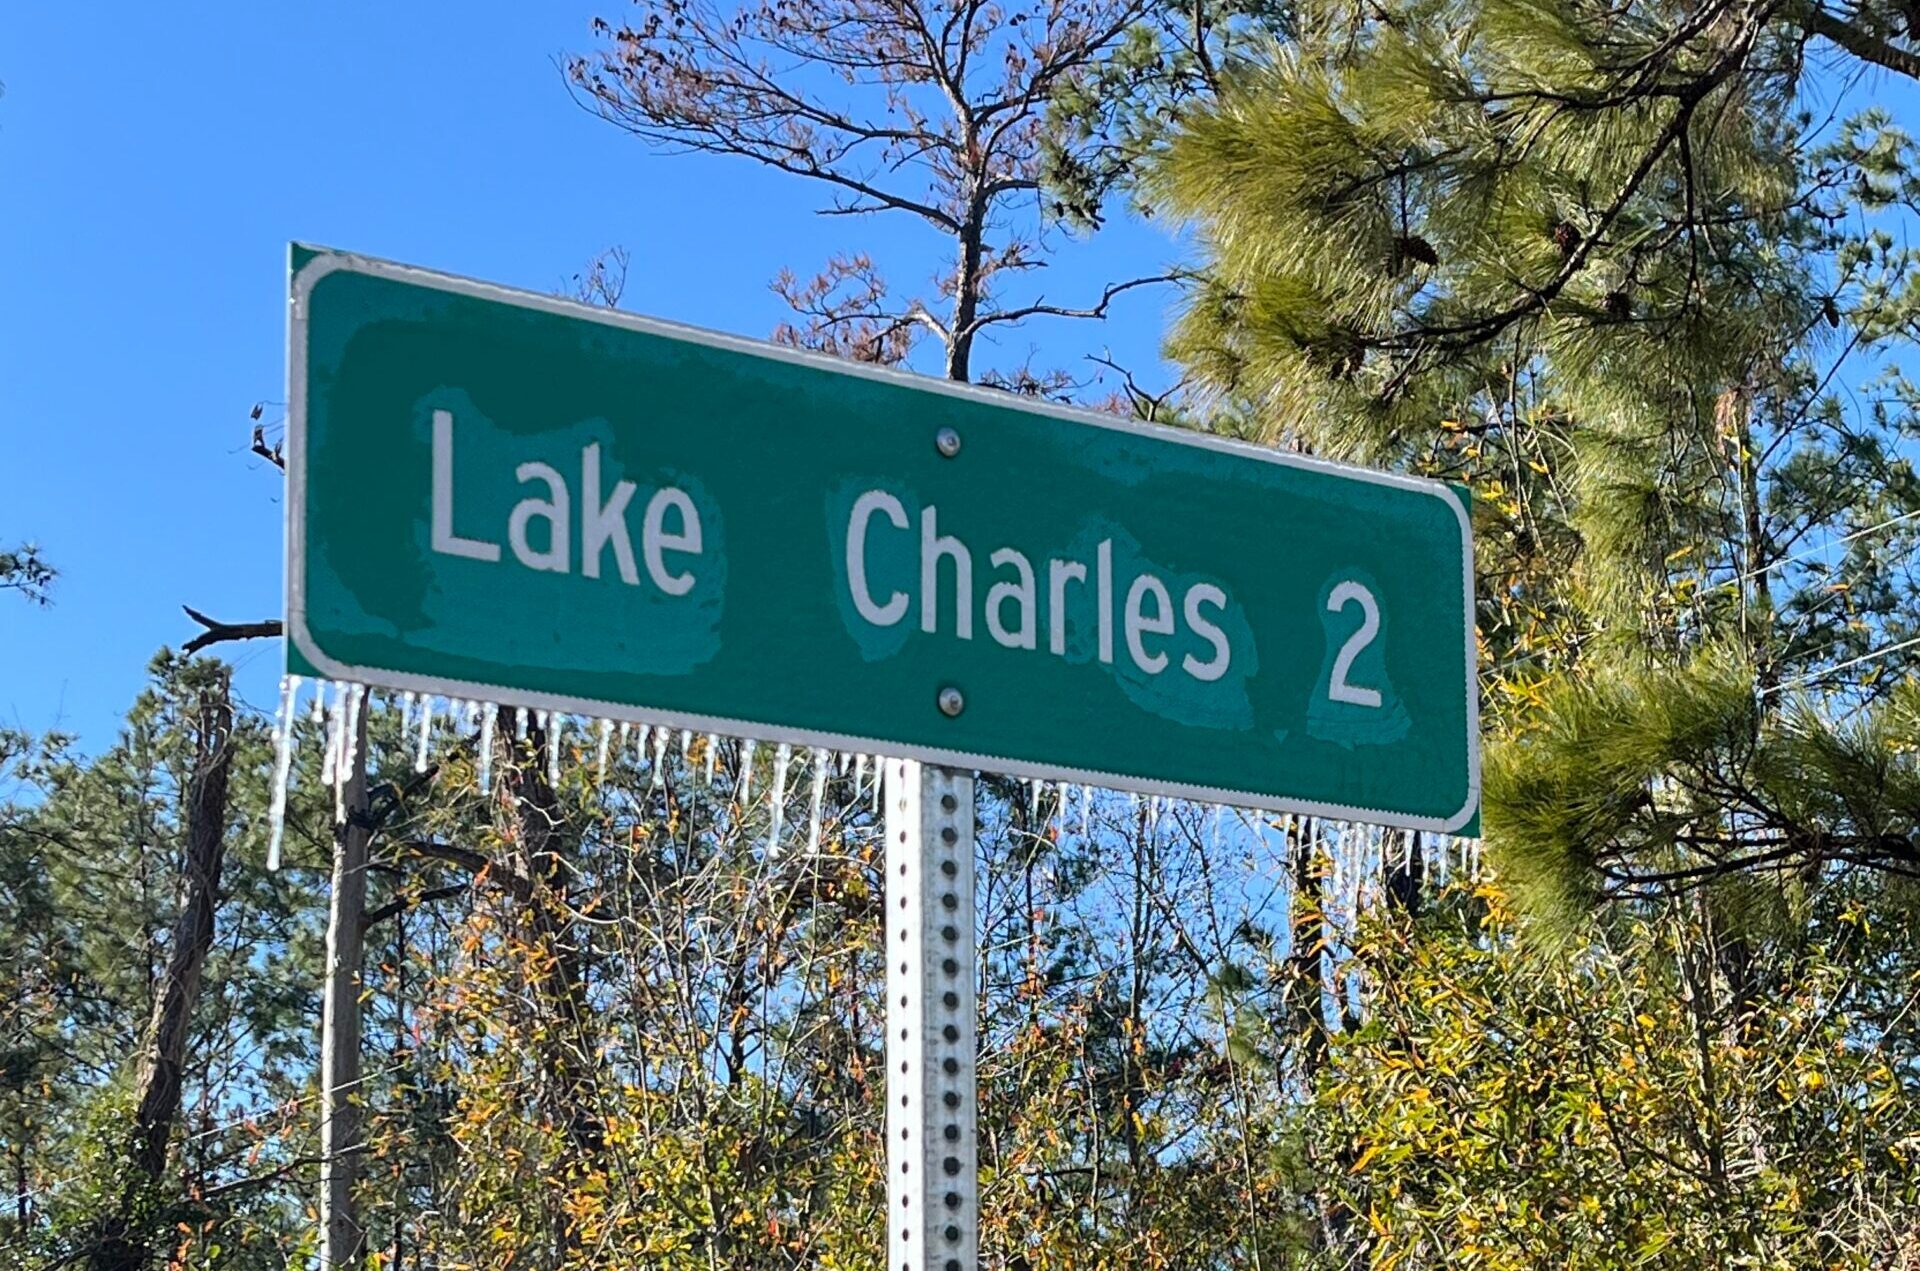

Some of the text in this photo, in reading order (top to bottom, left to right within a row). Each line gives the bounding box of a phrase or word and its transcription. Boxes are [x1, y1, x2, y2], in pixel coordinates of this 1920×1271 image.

[432, 410, 1382, 708] Lake Charles 2
